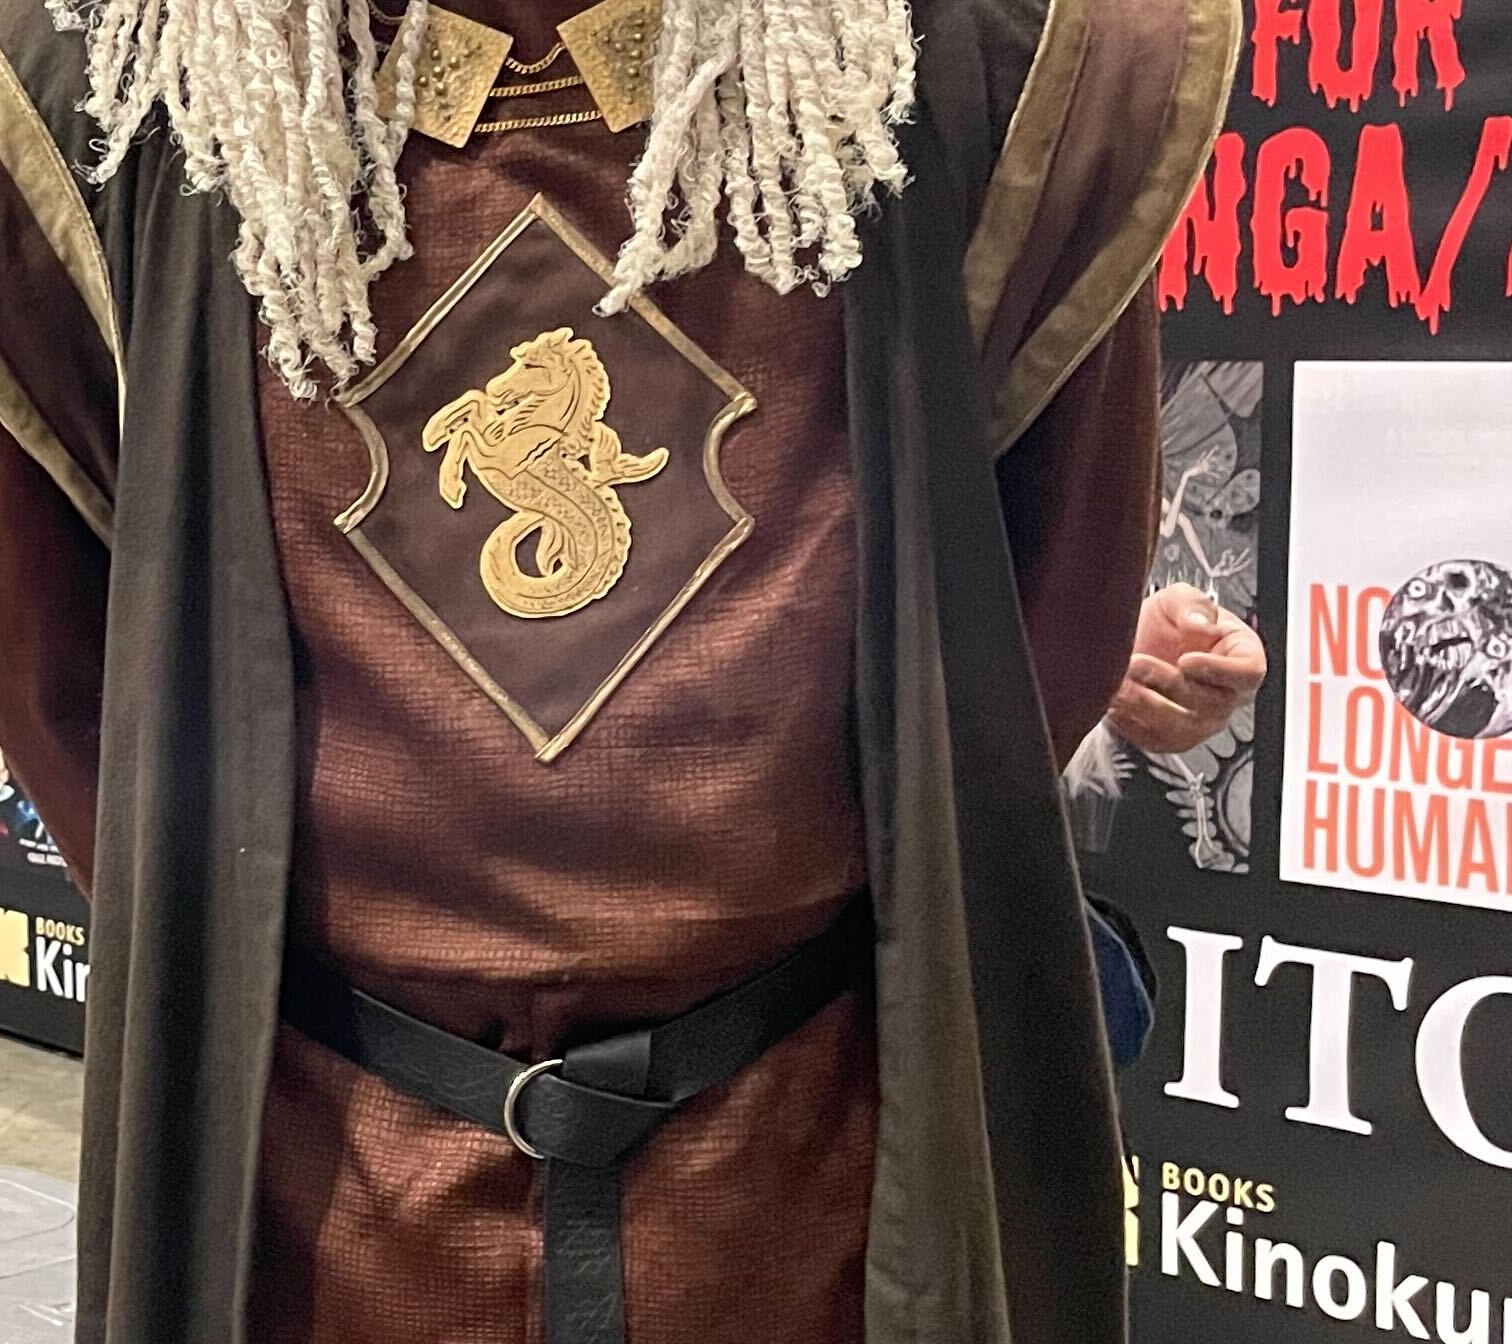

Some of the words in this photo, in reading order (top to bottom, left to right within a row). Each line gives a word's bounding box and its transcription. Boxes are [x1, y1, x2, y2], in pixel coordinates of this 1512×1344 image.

[1158, 115, 1512, 336] NGA/
[1302, 782, 1512, 895] HUMA
[35, 917, 86, 946] BOOKS
[1161, 1162, 1276, 1213] BOOKS
